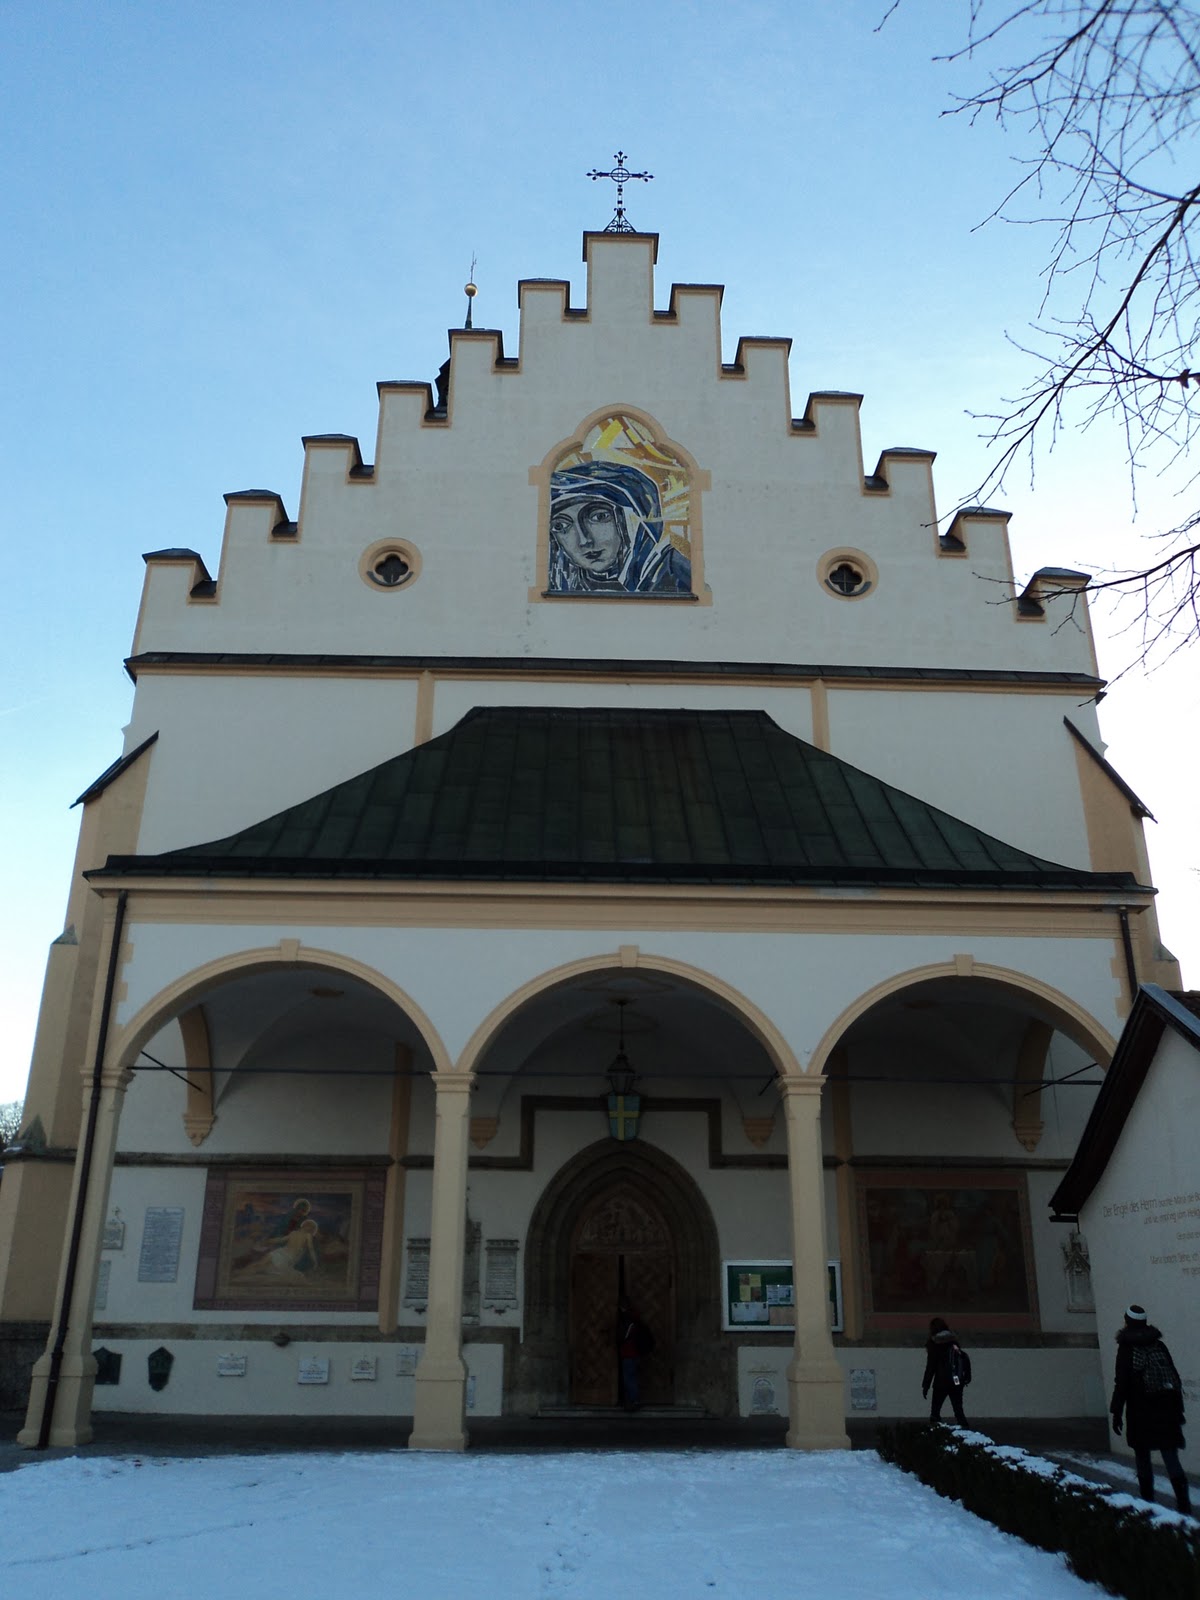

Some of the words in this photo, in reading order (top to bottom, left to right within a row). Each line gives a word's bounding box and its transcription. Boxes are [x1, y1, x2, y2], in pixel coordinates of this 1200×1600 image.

[1103, 1206, 1112, 1218] Der
[1113, 1202, 1128, 1218] Engel
[1130, 1201, 1140, 1212] des
